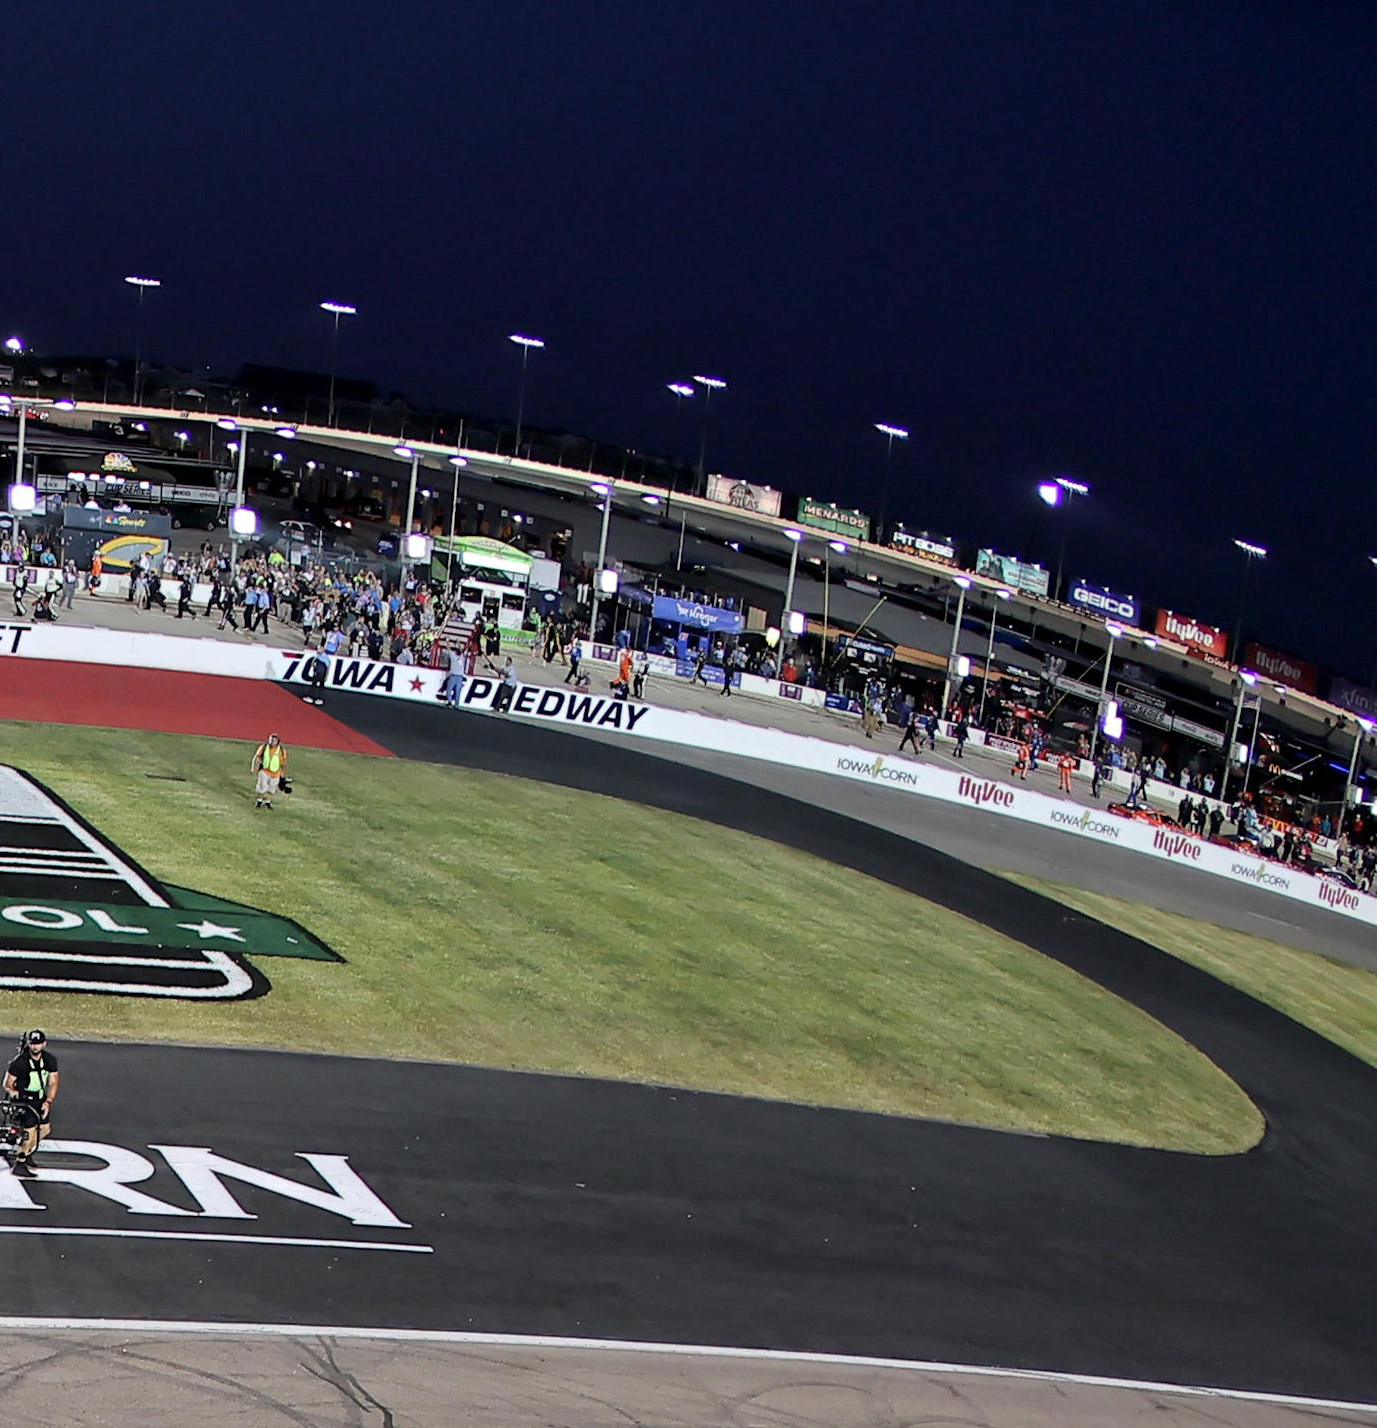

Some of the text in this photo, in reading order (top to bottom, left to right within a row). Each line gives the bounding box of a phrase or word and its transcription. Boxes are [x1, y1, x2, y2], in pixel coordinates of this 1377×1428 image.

[804, 504, 867, 528] MENARDS
[893, 531, 915, 546] PIT
[916, 535, 954, 558] BOSS
[1073, 587, 1134, 618] GEICO
[1166, 616, 1214, 648] HyVee
[837, 757, 919, 786] IOWA CORN
[958, 775, 1014, 808] HyVee
[1050, 808, 1120, 838] IOWA CORN
[1153, 829, 1201, 860] HyVee
[1231, 863, 1290, 890] IOWA CORN
[1319, 882, 1360, 910] HyVee
